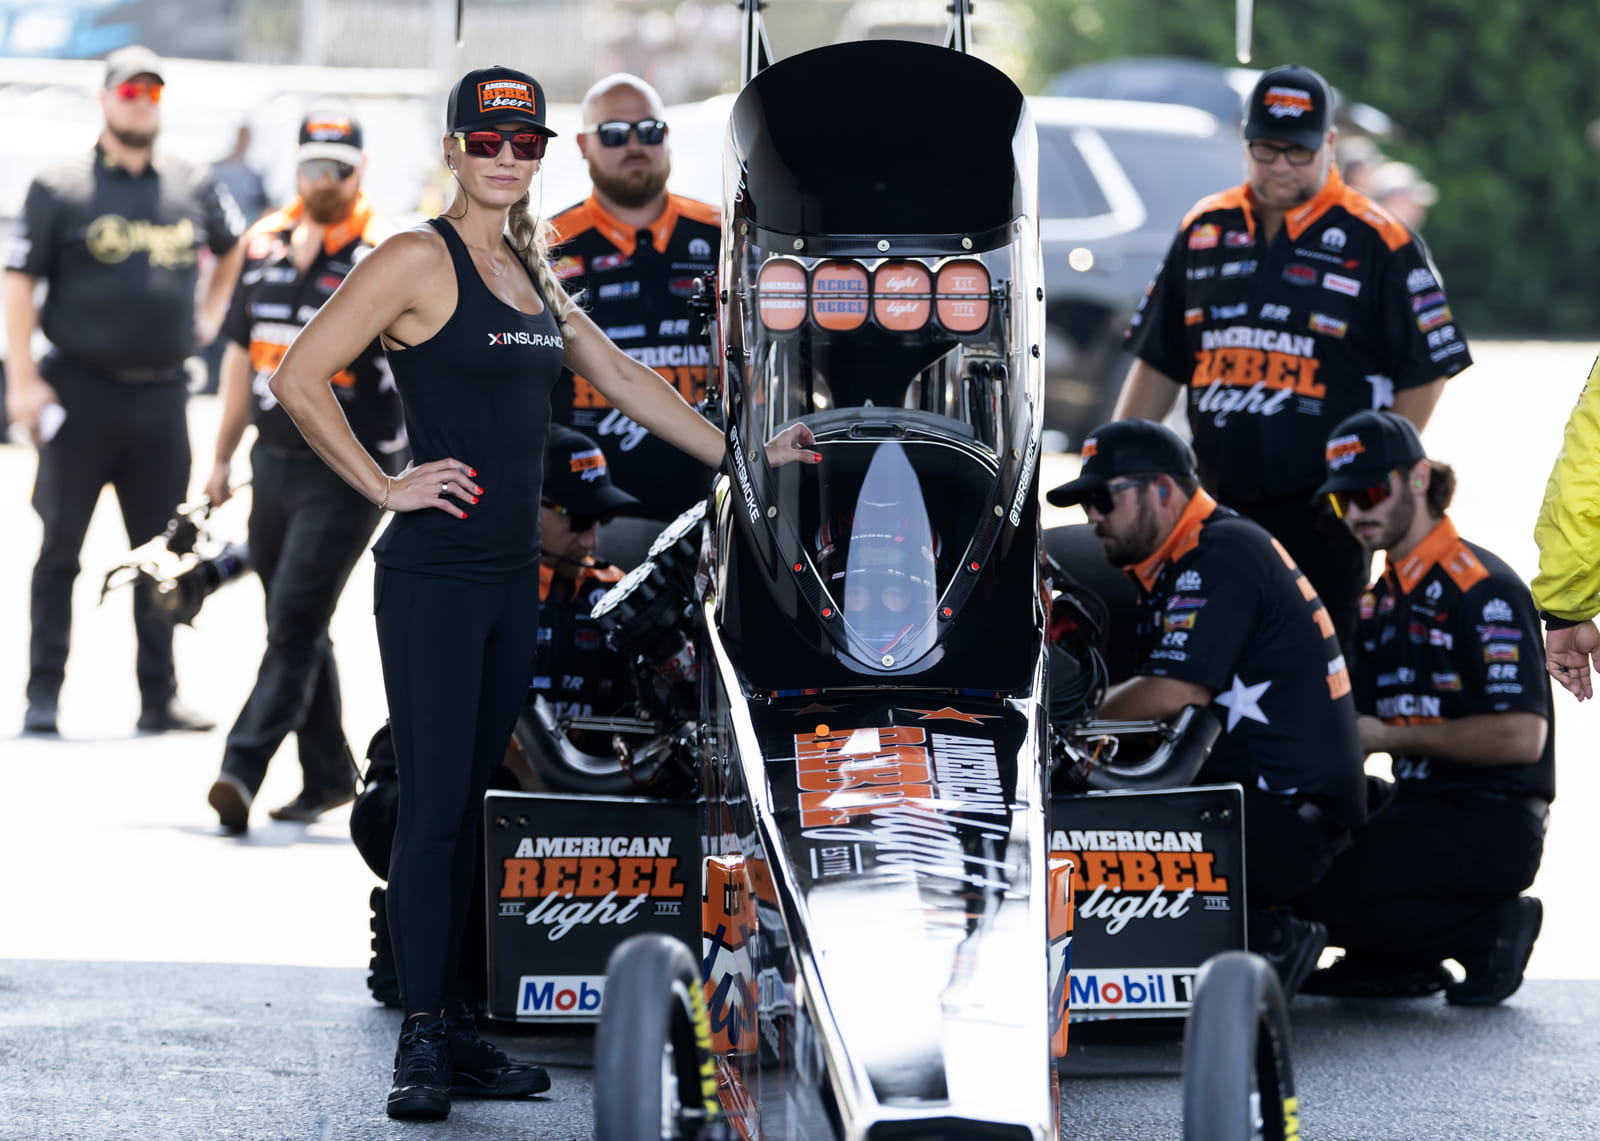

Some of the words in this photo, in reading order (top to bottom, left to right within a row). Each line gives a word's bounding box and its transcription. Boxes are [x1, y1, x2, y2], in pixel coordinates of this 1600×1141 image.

[483, 87, 531, 102] REBEL
[485, 82, 527, 91] AMERICAN
[492, 95, 526, 107] beer
[816, 280, 865, 292] REBEL
[816, 301, 865, 313] REBEL
[1199, 378, 1294, 428] light
[515, 836, 672, 858] AMERICAN
[1050, 830, 1203, 852] AMERICAN
[500, 857, 685, 898] REBEL
[525, 890, 649, 942] light
[1078, 884, 1194, 935] light
[522, 981, 602, 1012] Mob
[1070, 974, 1166, 1004] Mobil
